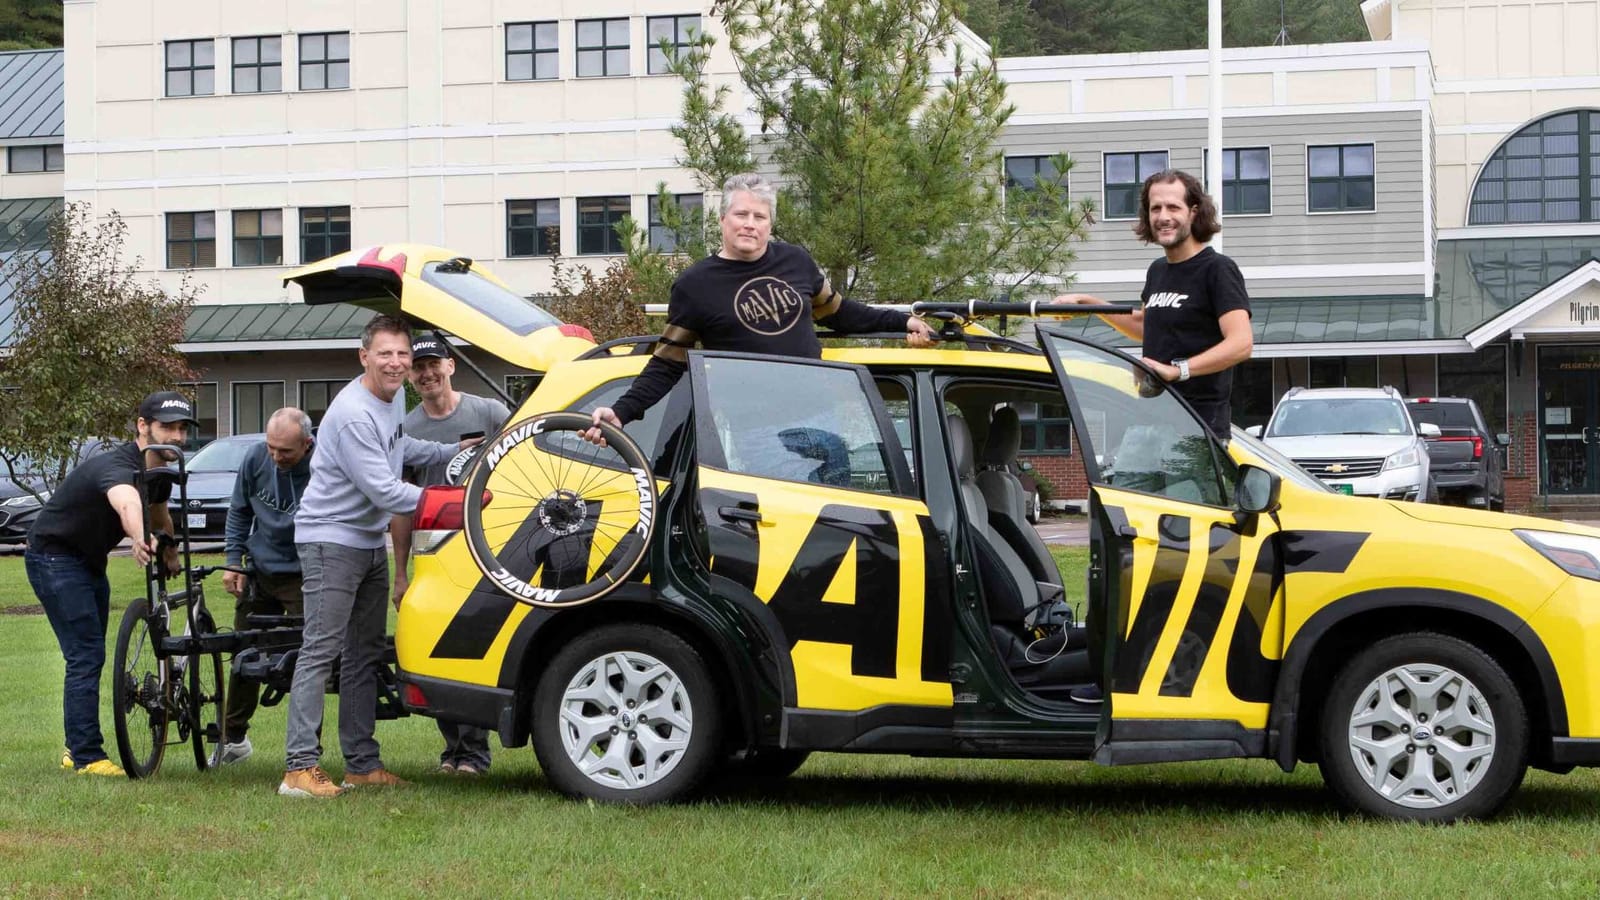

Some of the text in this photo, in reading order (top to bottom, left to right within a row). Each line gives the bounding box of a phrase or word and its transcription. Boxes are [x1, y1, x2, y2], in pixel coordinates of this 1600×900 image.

[739, 283, 797, 327] MAVIC
[1570, 302, 1600, 325] Pilgrim
[450, 448, 476, 476] MAVIC
[487, 419, 546, 470] MAVIC
[630, 467, 652, 539] MAVIC
[491, 568, 563, 602] MAVIC
